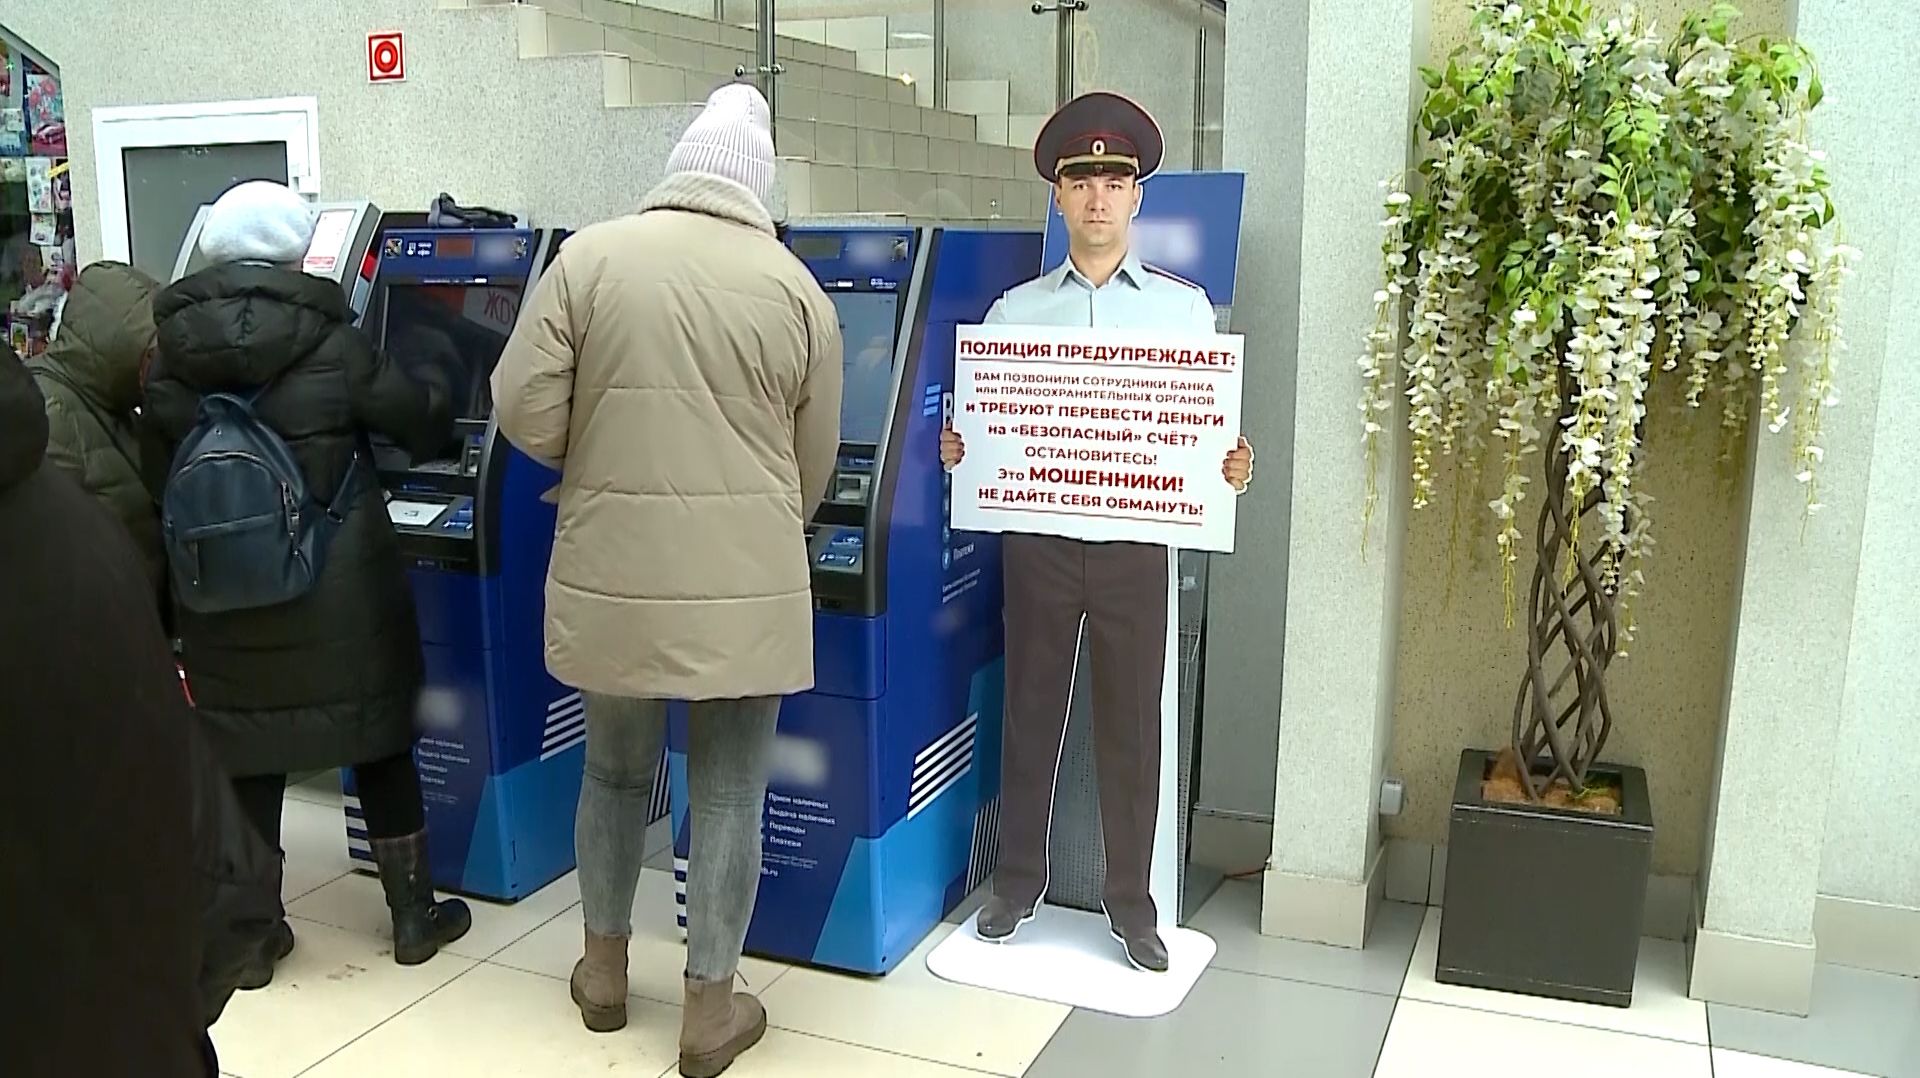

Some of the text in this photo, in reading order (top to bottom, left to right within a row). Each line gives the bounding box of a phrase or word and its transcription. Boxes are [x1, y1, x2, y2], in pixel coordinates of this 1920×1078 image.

[960, 340, 1236, 366] ПОЛИЦИЯ ПРЕДУПРЕЖДАЕТ:
[974, 372, 1214, 392] ВАМ ПОЗВОНИЛИ СОТРУДНИКИ БАНКА
[1000, 386, 1152, 402] ПРАВООХРАНИТЕЛЬНЫХ
[1155, 394, 1215, 405] ОРГАНОВ
[965, 402, 976, 413] и
[979, 402, 1054, 416] ТРЕБУЮТ
[1058, 406, 1153, 421] ПЕРЕВЕСТИ
[1156, 412, 1224, 427] ДЕНЬГИ
[988, 424, 1198, 446] на «БЕЗОПАСНЫЙ» СЧЁТ?
[1024, 446, 1158, 465] ОСТАНОВИТЕСЬ!
[997, 466, 1184, 492] Это МОШЕННИКИ!
[978, 488, 1204, 516] НЕ ДАЙТЕ СЕБЯ ОБМАНУТЬ!
